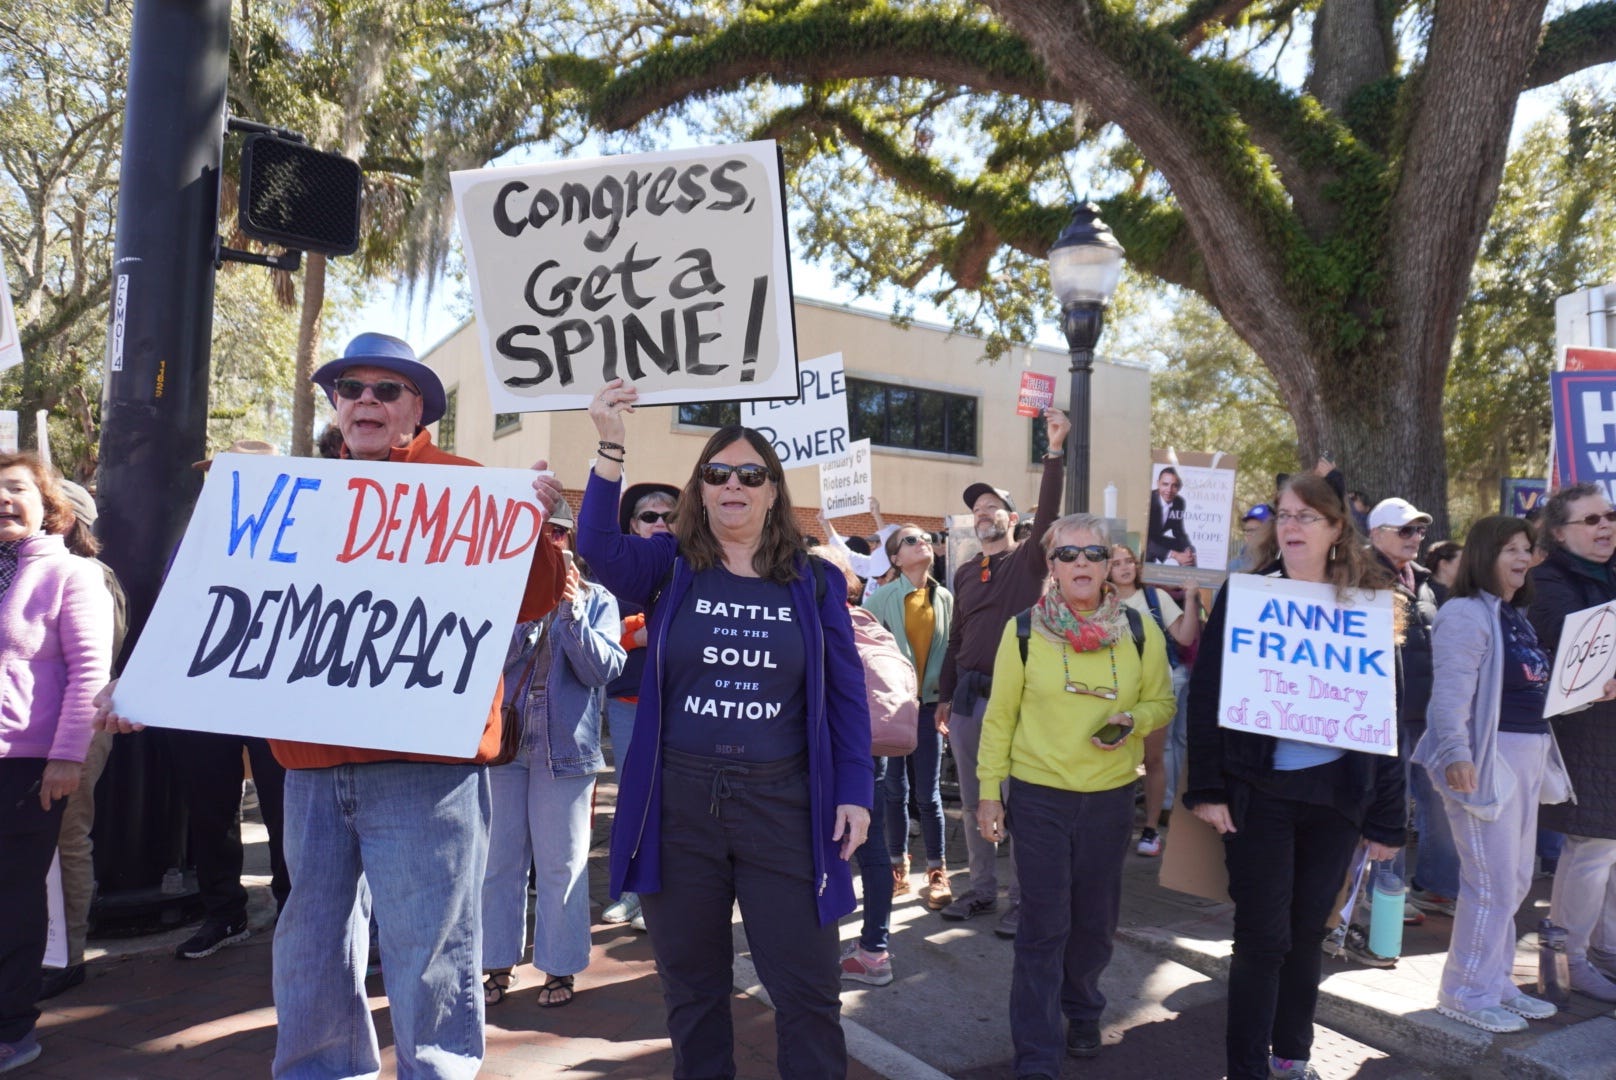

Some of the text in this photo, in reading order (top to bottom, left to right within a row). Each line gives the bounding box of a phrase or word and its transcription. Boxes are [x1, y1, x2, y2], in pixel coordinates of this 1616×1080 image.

[493, 160, 756, 252] Congress,
[524, 242, 726, 318] Get a
[496, 274, 768, 387] SPINE!
[823, 471, 868, 492] Rioters Are
[827, 493, 865, 511] Criminals
[1168, 510, 1224, 521] AUDACITY
[228, 471, 543, 566] WE DEMAND
[1192, 531, 1223, 543] HOPE
[695, 599, 792, 622] BATTLE
[1258, 598, 1367, 638] ANNE
[187, 583, 493, 694] DEMOCRACY
[713, 627, 769, 638] FOR THE
[703, 646, 777, 669] SOUL
[1231, 627, 1388, 677] FRANK
[715, 679, 760, 690] OF THE
[1258, 668, 1368, 711] The Diary
[684, 695, 781, 720] NATION
[1226, 697, 1392, 746] of a Young Girl
